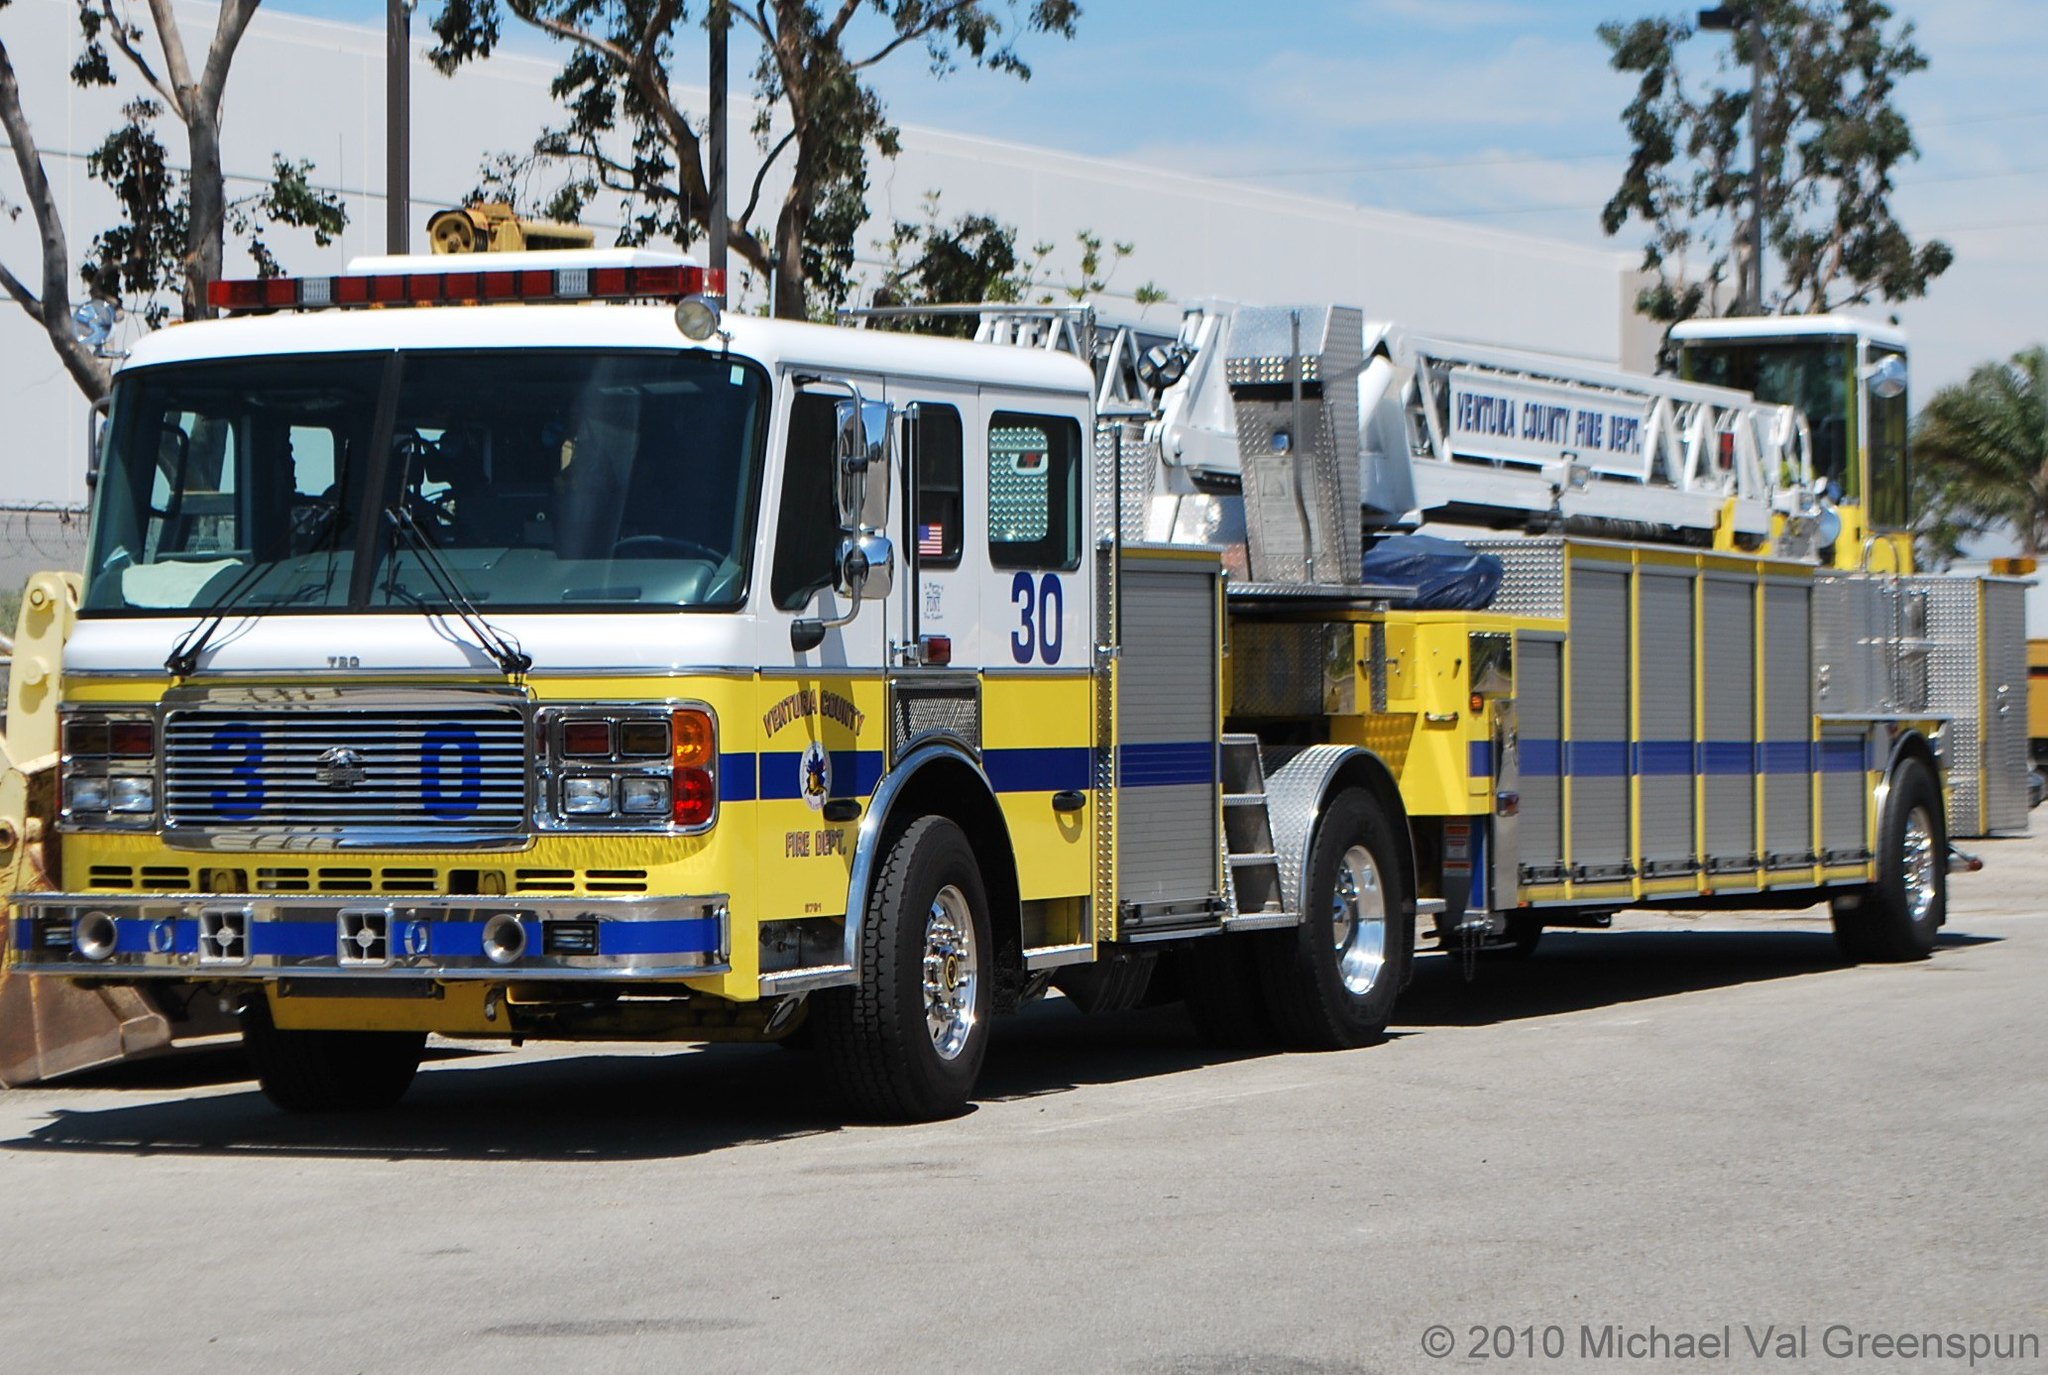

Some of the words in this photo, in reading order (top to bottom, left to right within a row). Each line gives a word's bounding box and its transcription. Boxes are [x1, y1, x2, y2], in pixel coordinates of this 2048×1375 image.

[1457, 392, 1515, 438] VENTURA
[1522, 402, 1571, 445] COUNTY
[1575, 410, 1602, 450] FIRE
[1608, 415, 1640, 455] DEPT.
[1011, 571, 1063, 666] 30
[763, 689, 818, 738] VENTURA
[820, 690, 866, 737] COUNTY
[210, 722, 266, 821] 3
[420, 722, 481, 821] 0
[785, 831, 811, 858] FIRE
[815, 829, 847, 857] DEPT.
